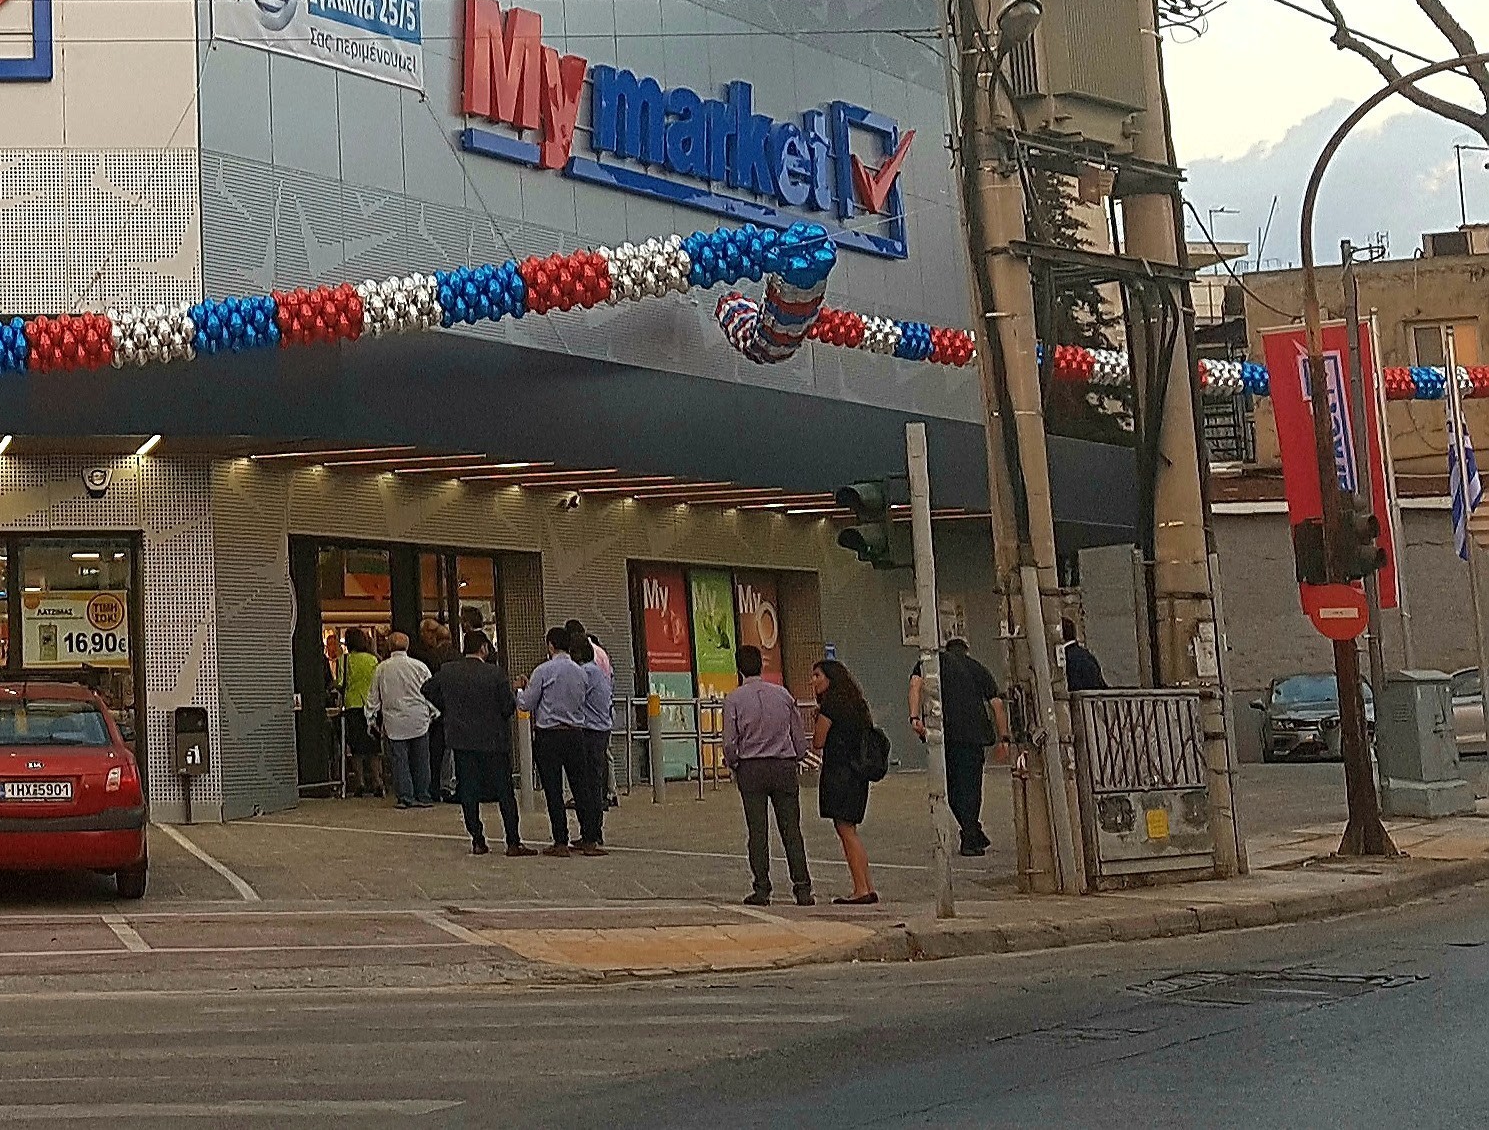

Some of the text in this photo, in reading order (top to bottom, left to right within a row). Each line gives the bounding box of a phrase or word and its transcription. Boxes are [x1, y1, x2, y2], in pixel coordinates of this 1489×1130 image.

[309, 26, 333, 52] Σας
[591, 64, 832, 212] market
[642, 578, 669, 618] My
